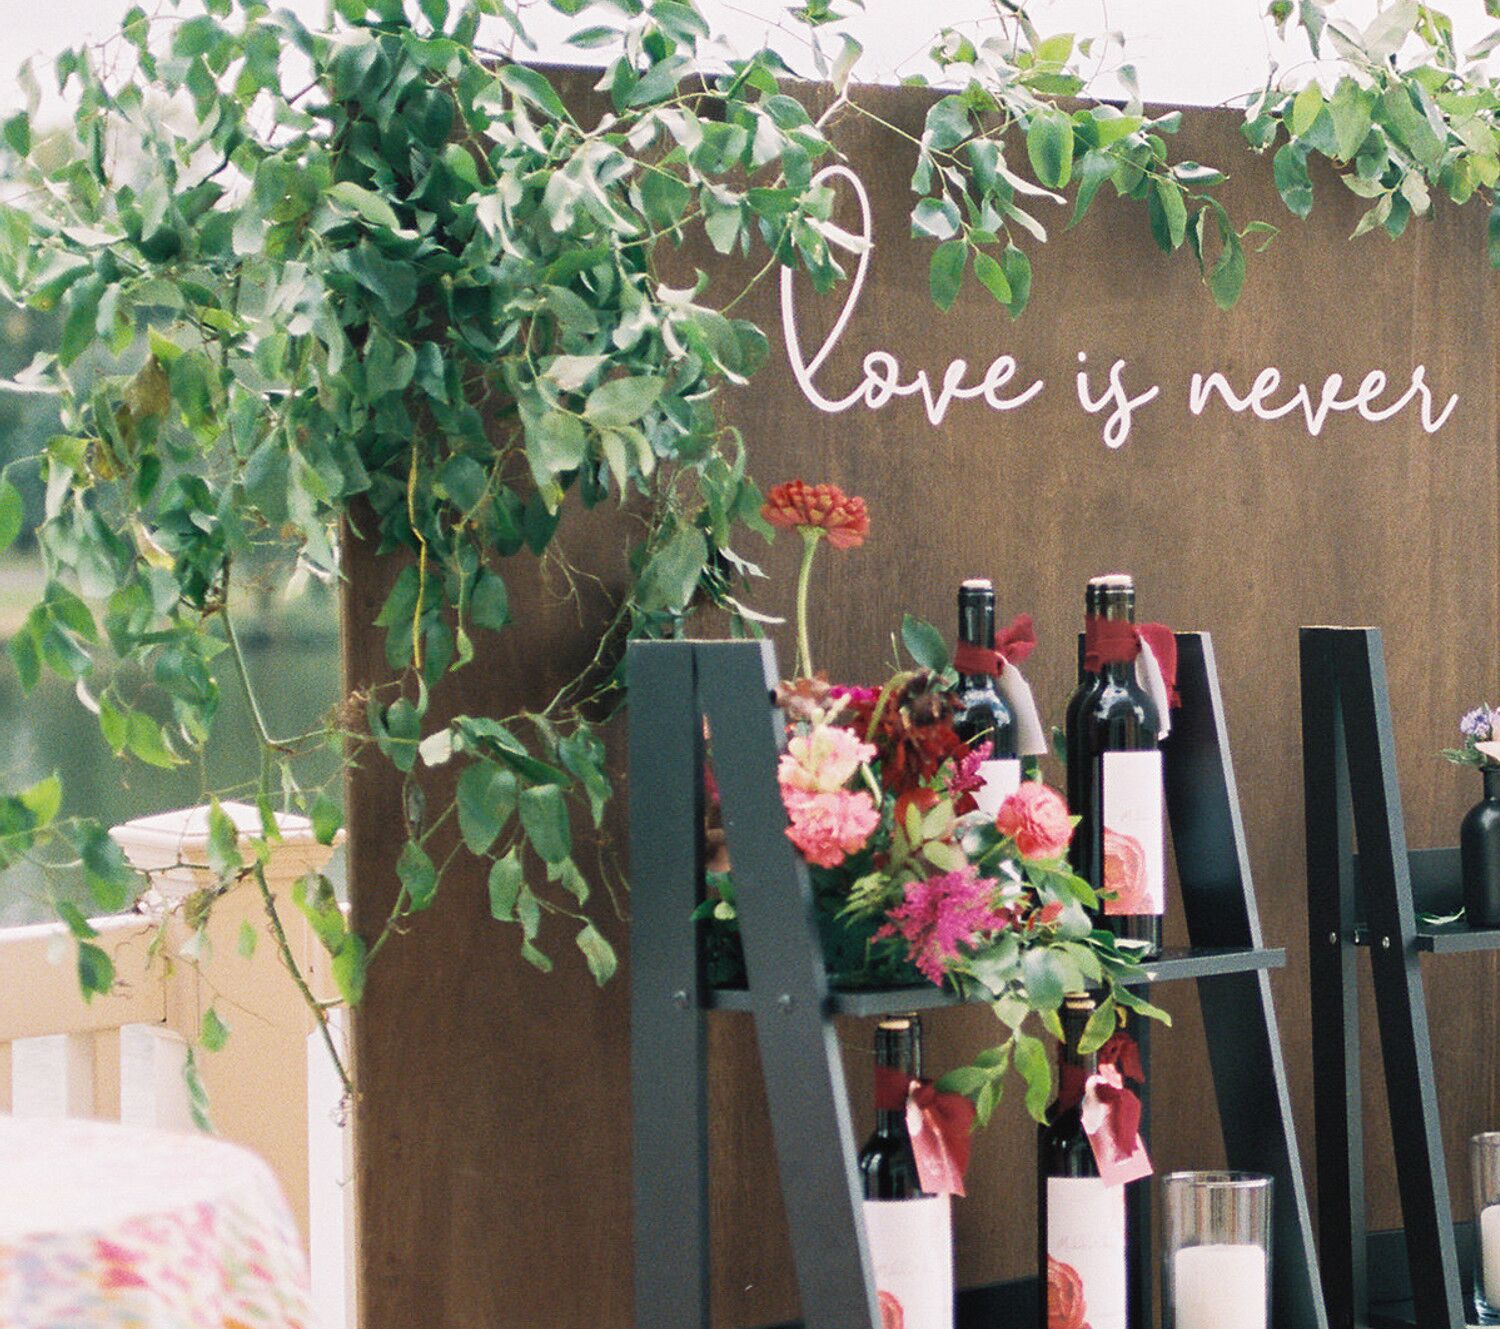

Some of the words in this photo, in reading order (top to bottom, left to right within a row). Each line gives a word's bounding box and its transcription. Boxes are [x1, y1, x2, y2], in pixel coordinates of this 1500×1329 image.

[781, 165, 1043, 425] love
[1077, 352, 1159, 448] is
[1190, 364, 1458, 436] never
